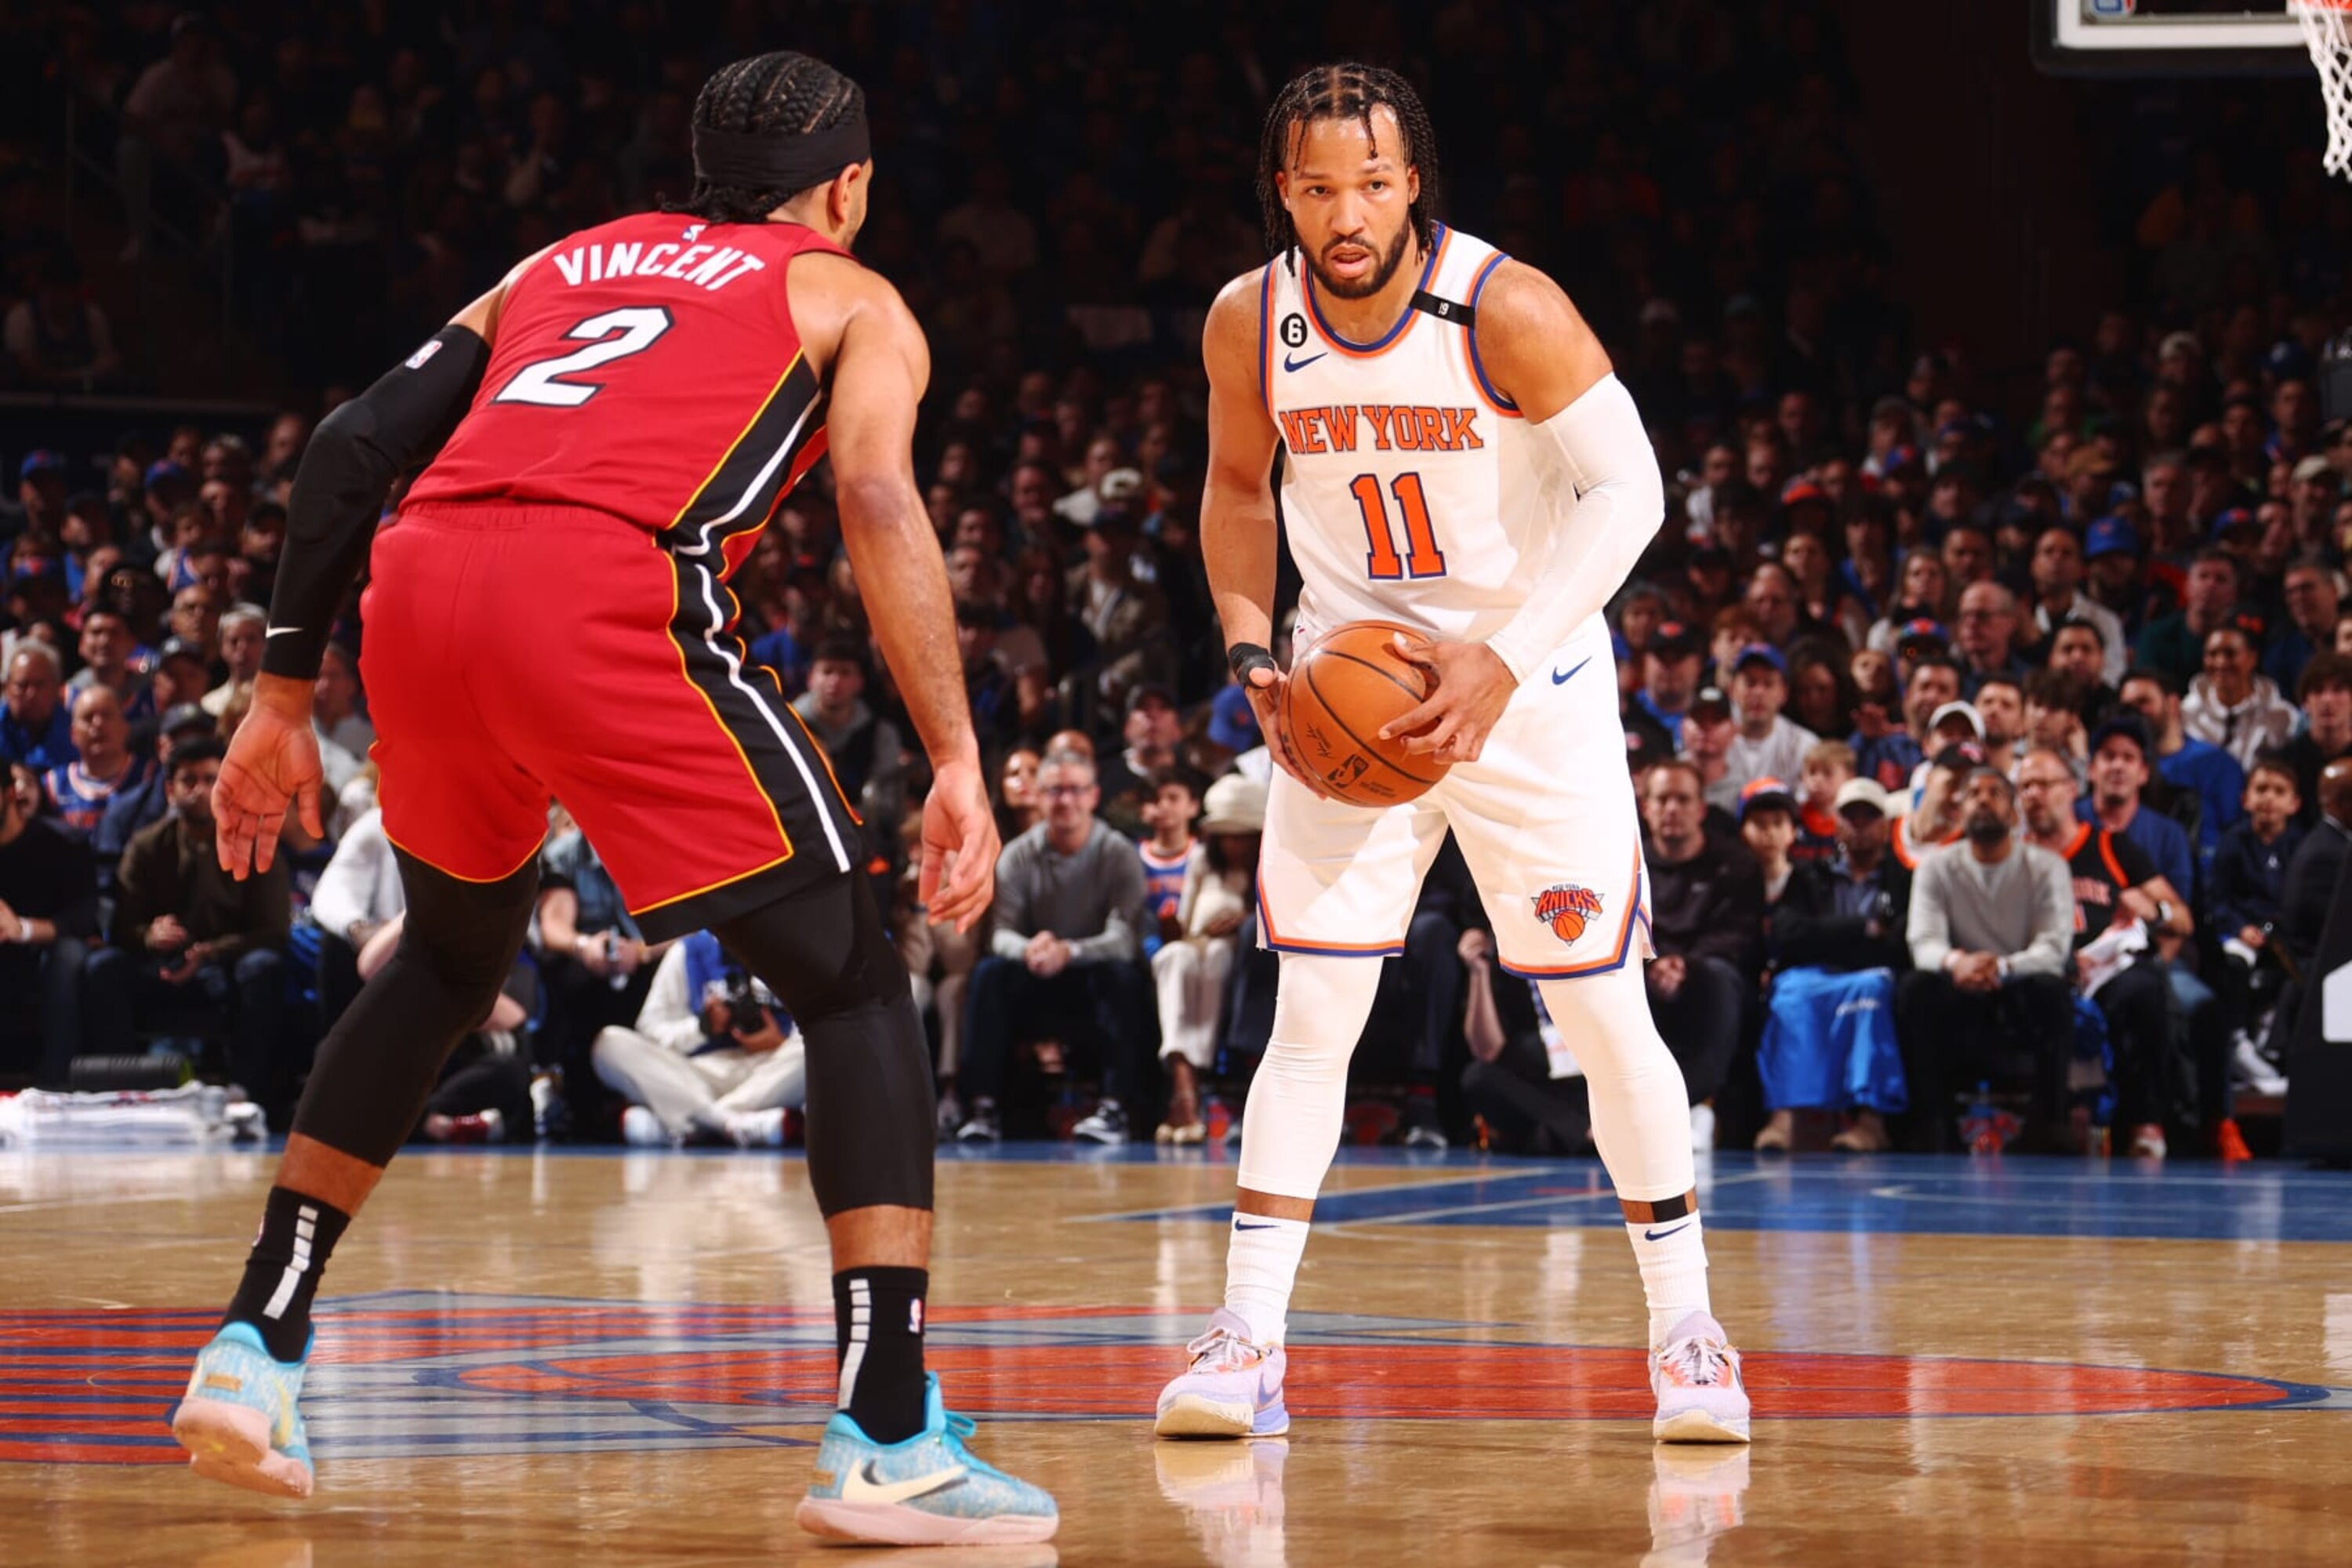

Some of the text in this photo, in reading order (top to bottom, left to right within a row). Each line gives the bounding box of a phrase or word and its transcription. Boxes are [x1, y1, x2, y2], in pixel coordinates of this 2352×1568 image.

[553, 242, 766, 292] VINCENT
[1287, 318, 1302, 343] 6
[489, 305, 677, 408] 2
[1278, 405, 1484, 455] NEW YORK
[1348, 471, 1447, 580] 11
[1534, 887, 1603, 919] KNICKS
